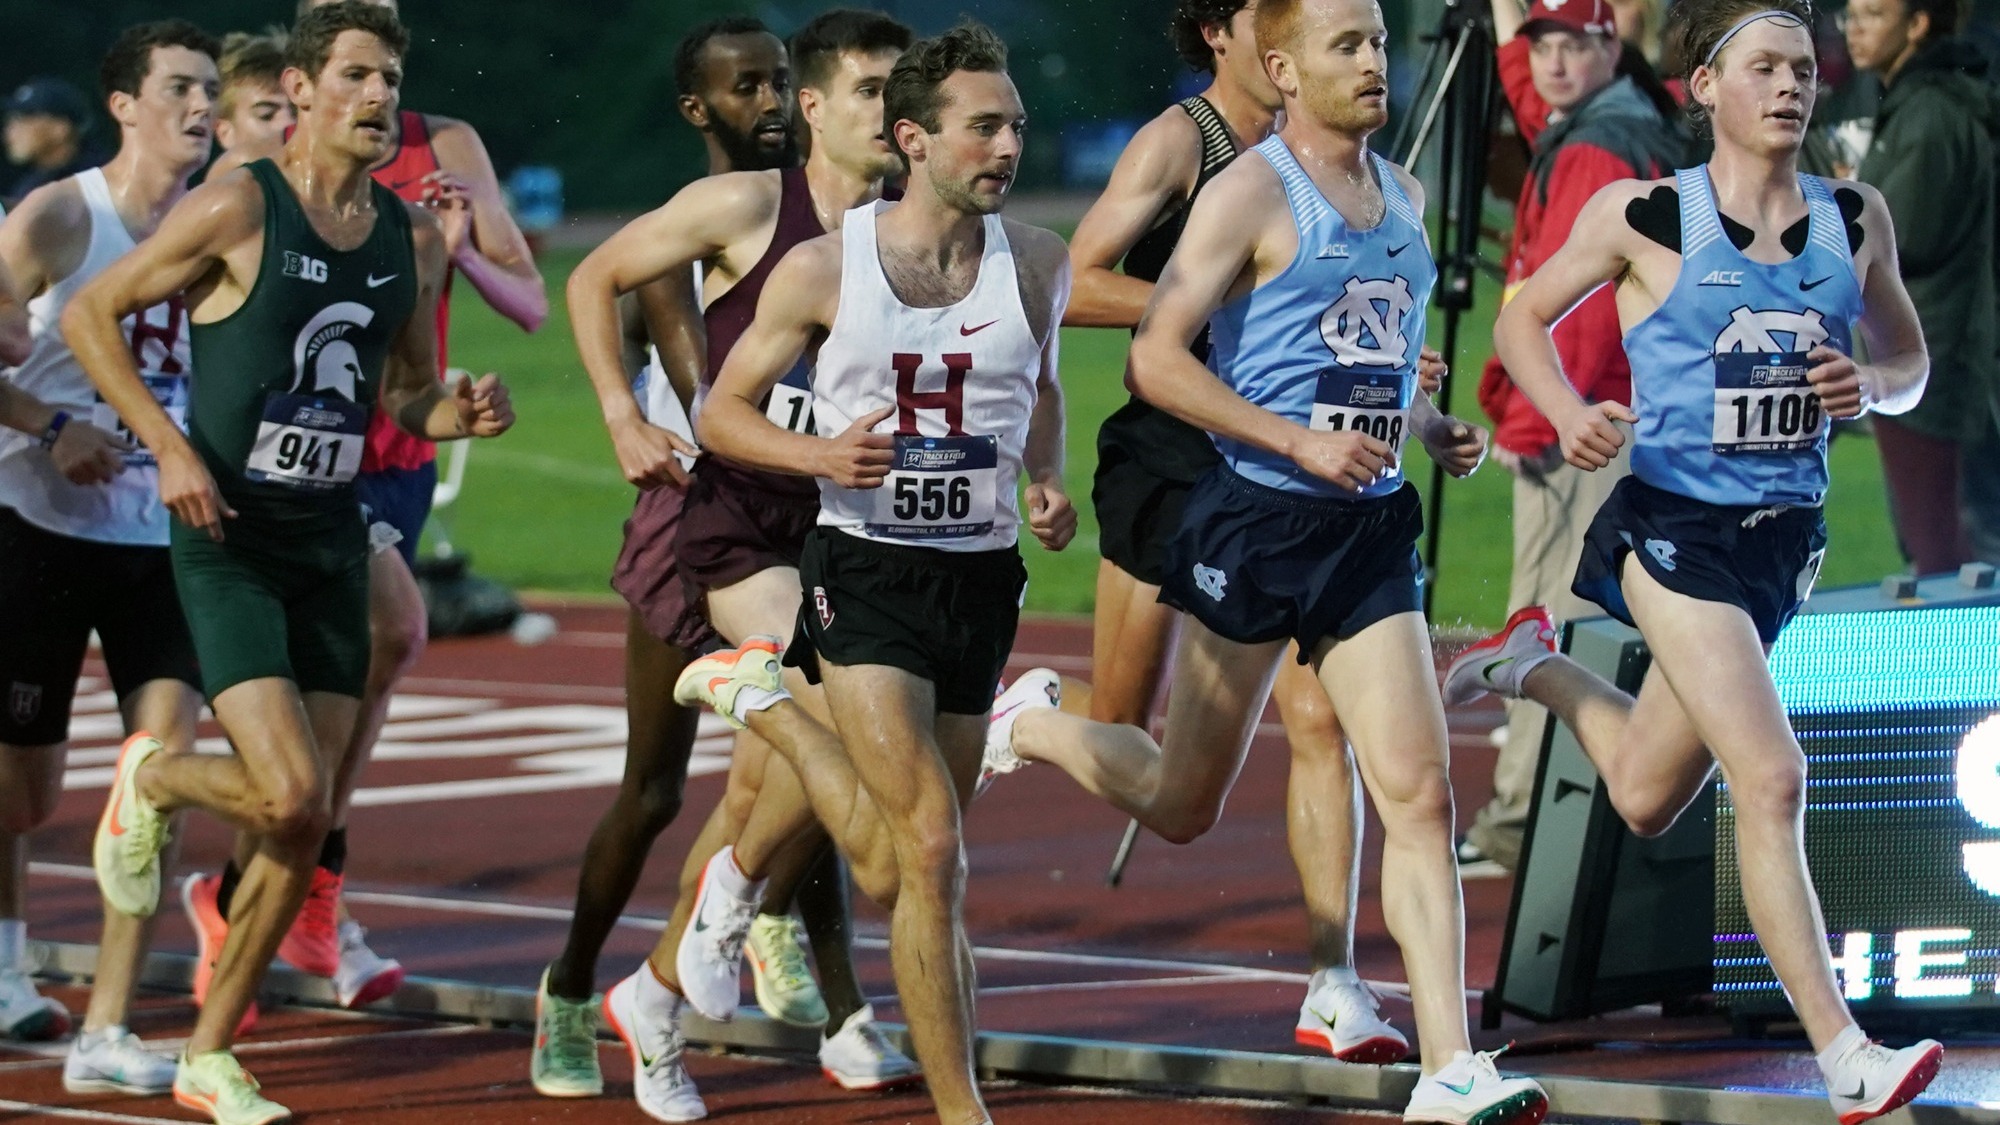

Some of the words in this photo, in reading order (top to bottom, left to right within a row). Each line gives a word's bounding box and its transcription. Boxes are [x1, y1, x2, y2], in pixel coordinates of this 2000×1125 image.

[1319, 243, 1349, 256] ACC
[1700, 270, 1744, 285] ACC
[891, 352, 973, 437] H
[1731, 392, 1820, 437] 1106
[276, 432, 342, 477] 941
[923, 452, 944, 460] TRACK
[949, 452, 966, 460] FIELD
[893, 476, 971, 521] 556
